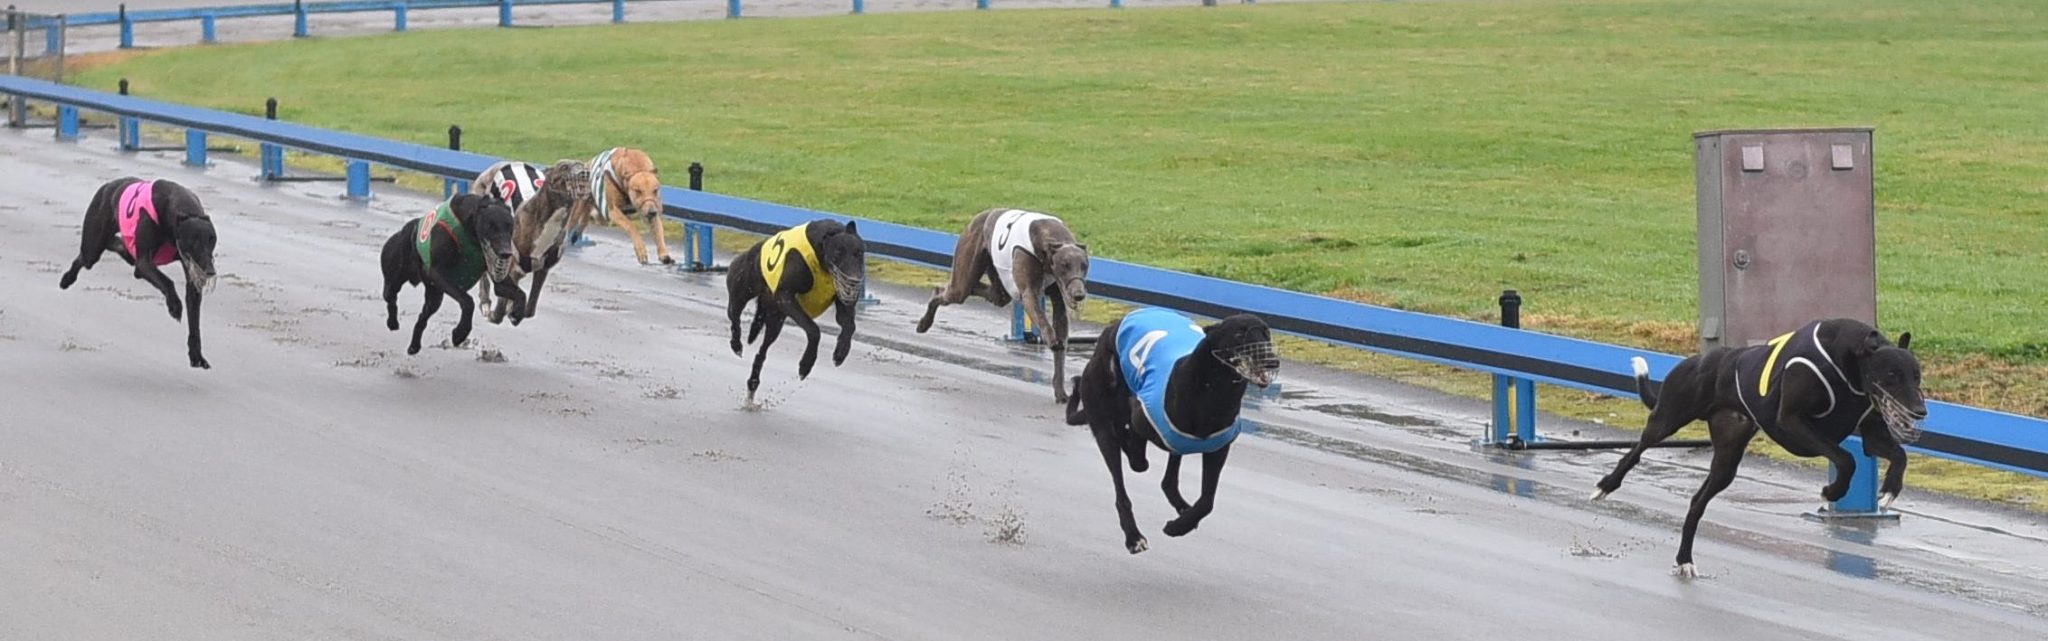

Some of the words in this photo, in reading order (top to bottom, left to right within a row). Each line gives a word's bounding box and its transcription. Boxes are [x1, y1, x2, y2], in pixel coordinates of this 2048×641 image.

[767, 232, 785, 271] 5
[1129, 330, 1168, 374] 4
[1759, 331, 1796, 396] 7
